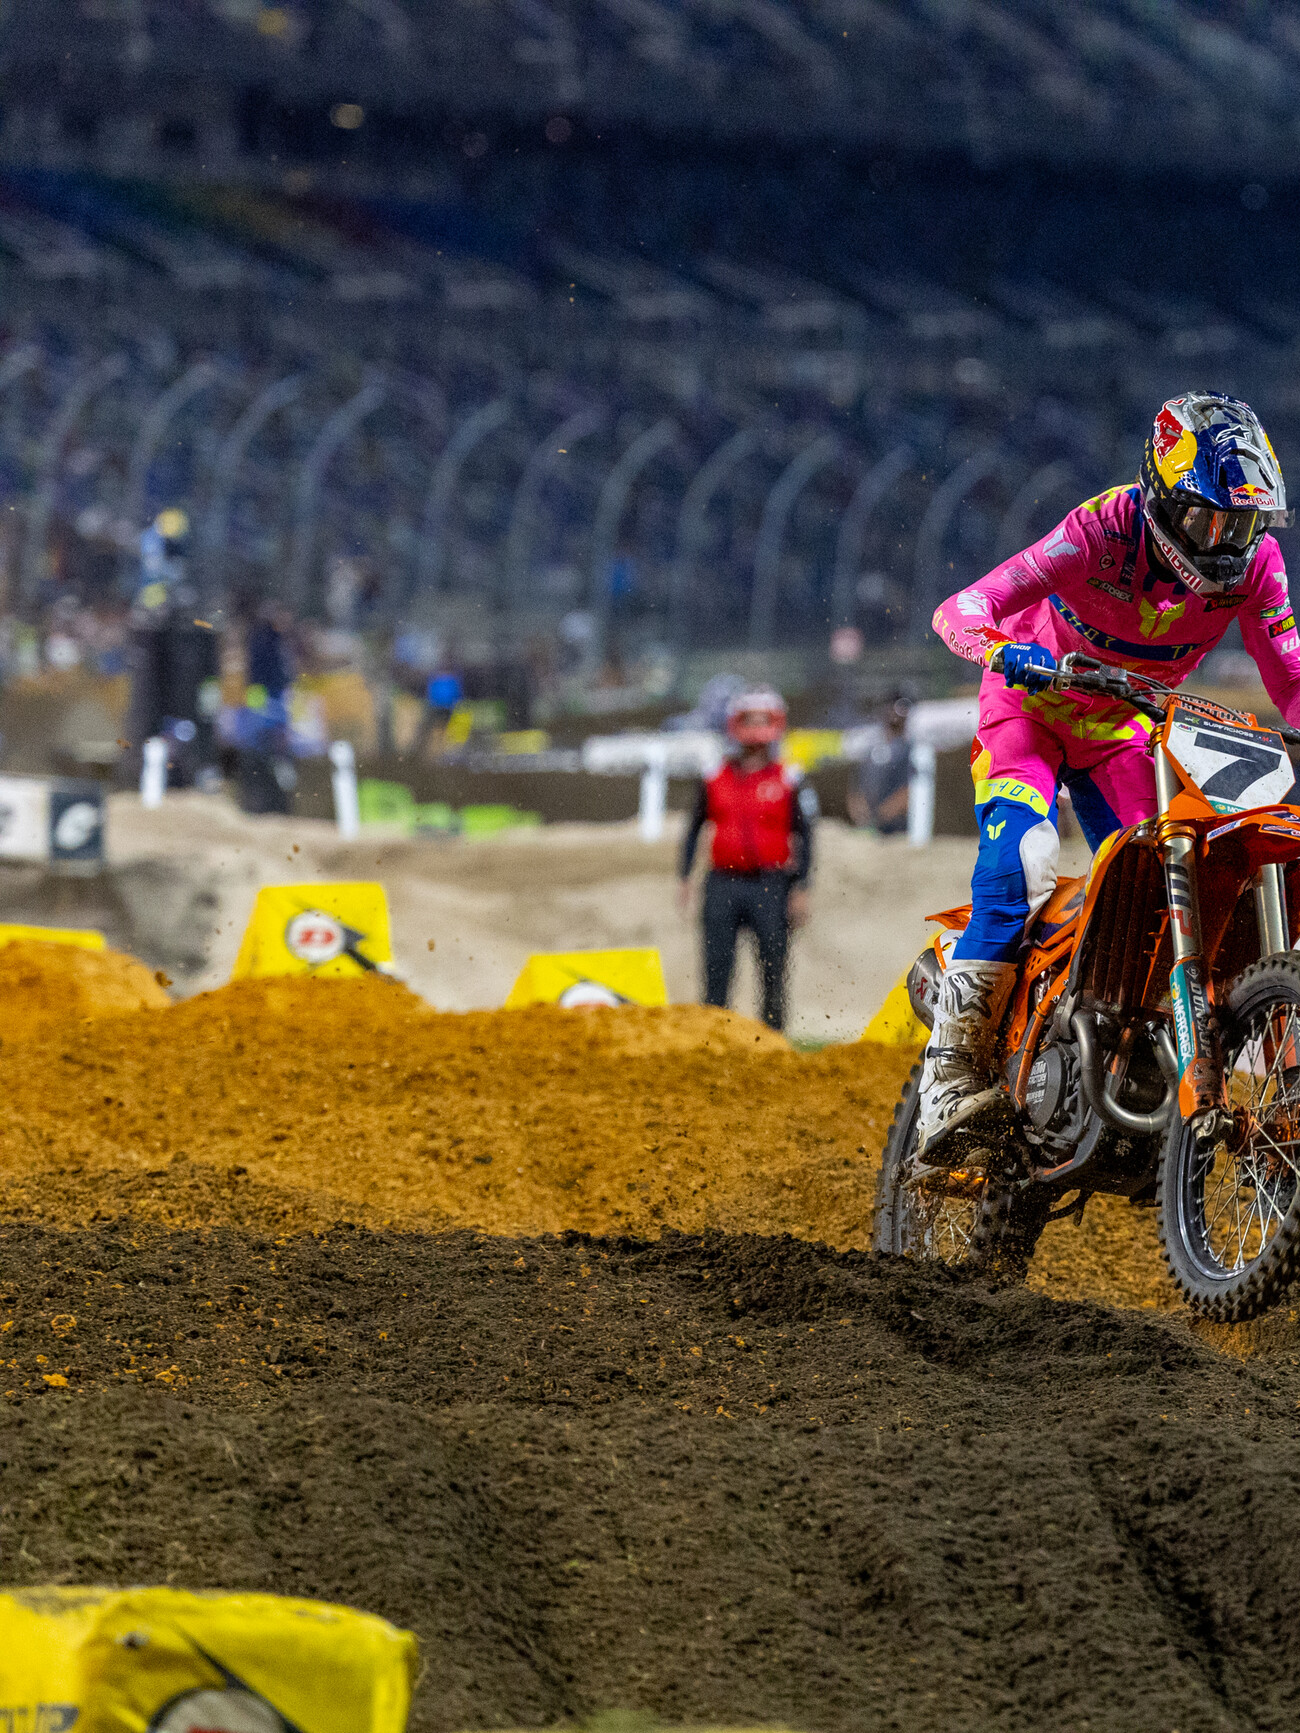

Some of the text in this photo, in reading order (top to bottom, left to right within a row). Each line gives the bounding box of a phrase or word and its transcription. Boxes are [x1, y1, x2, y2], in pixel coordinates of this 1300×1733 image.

[1232, 496, 1275, 506] Red Bull
[1010, 643, 1031, 651] THOR
[1203, 721, 1254, 738] SUPERCROSS
[1194, 732, 1282, 801] 7
[988, 781, 1039, 802] THOR
[1173, 998, 1193, 1063] MOTOREX
